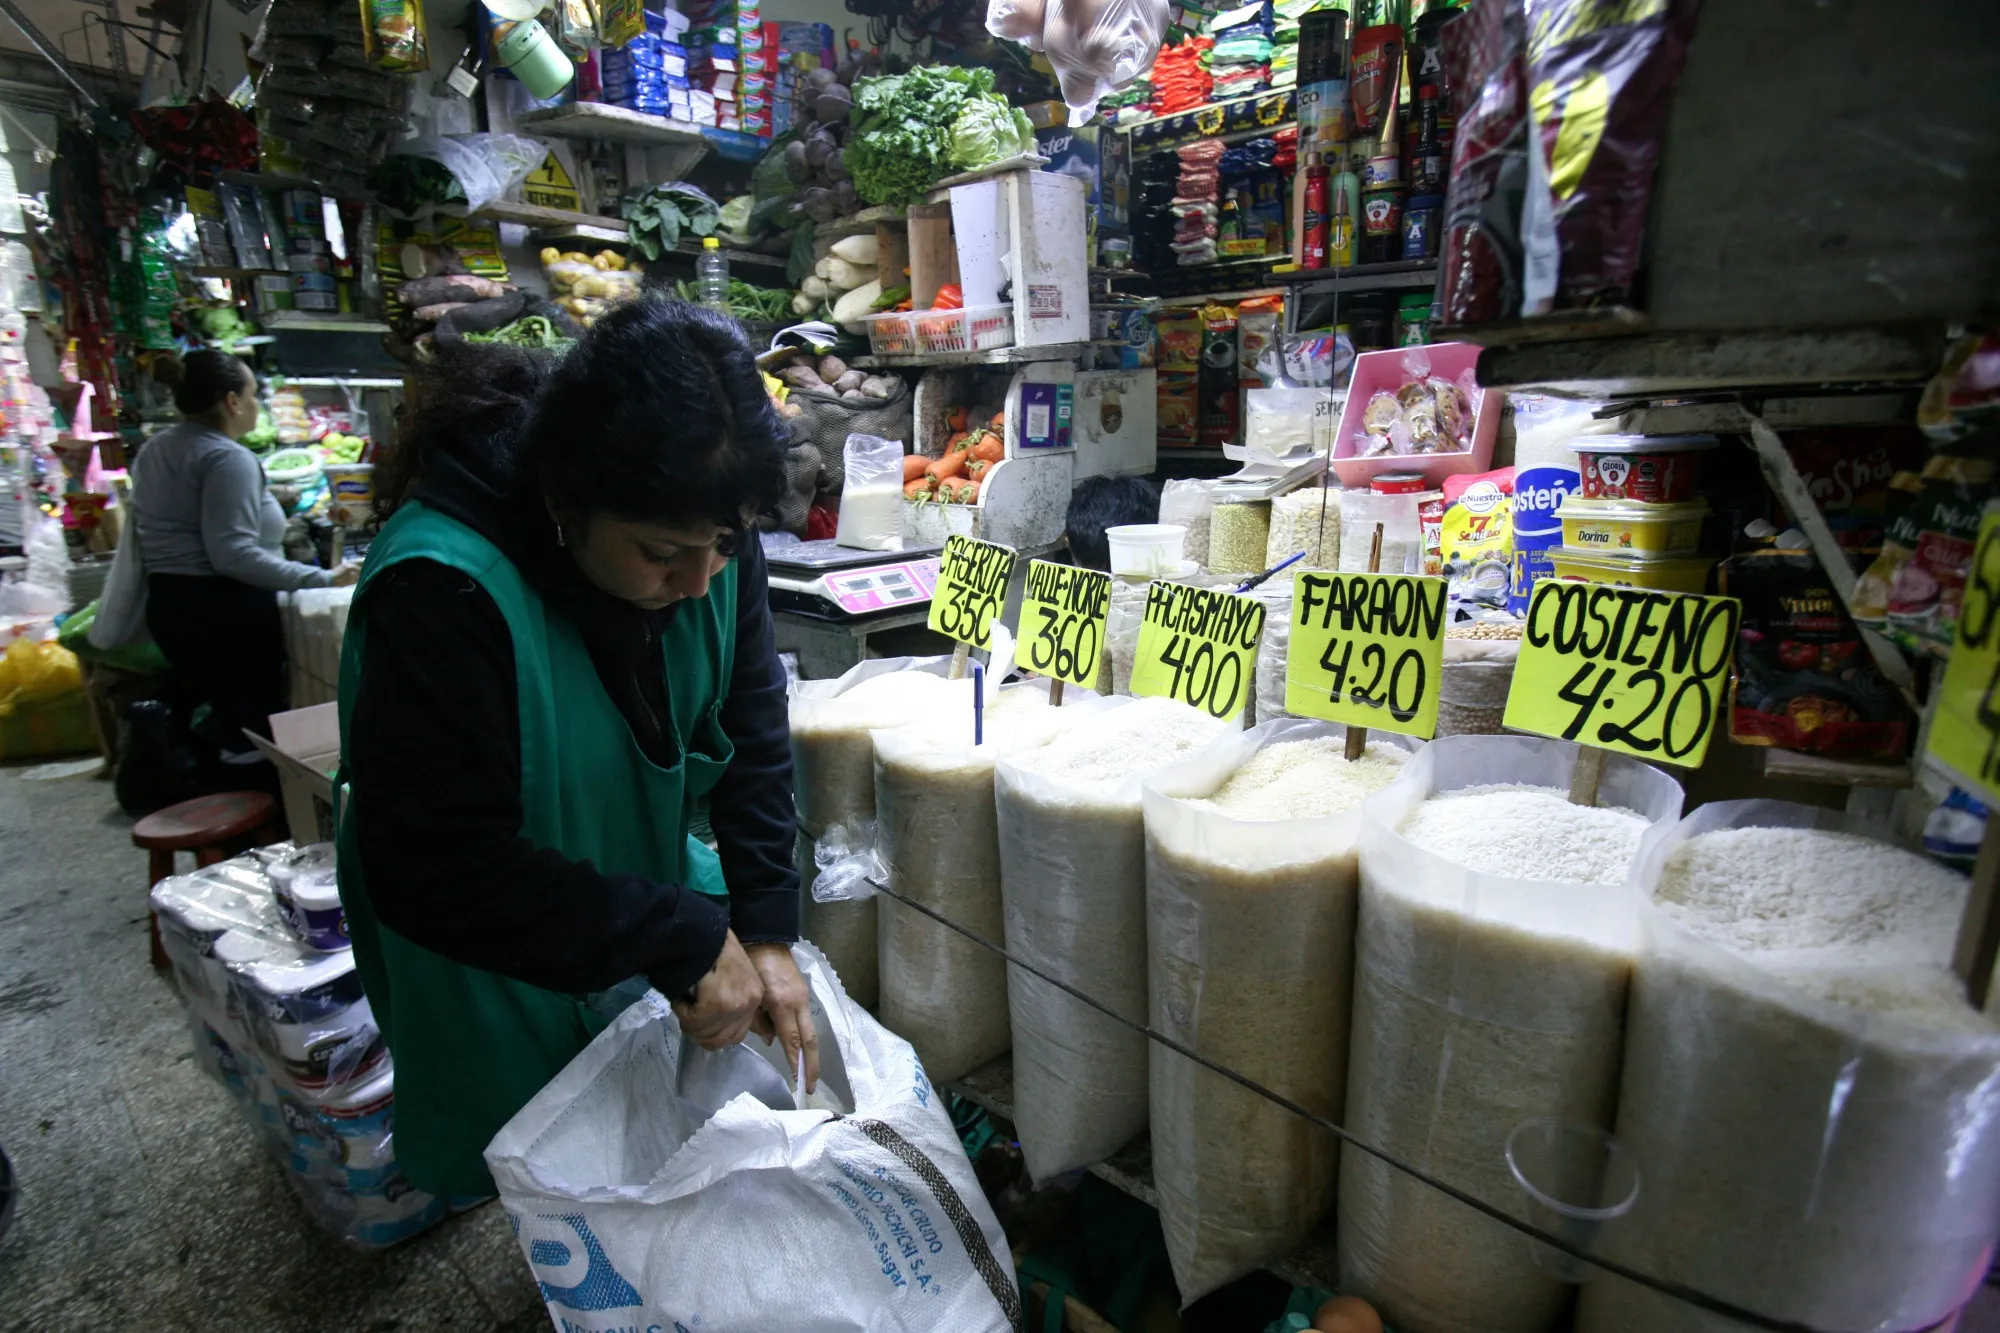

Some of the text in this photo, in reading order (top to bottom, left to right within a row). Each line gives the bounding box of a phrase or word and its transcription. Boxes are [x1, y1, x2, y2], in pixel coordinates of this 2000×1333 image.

[1040, 135, 1073, 157] ster
[1602, 461, 1625, 473] GLORIA
[1467, 493, 1503, 502] Nuestra
[1469, 516, 1491, 533] 7
[1459, 529, 1501, 541] Semillas
[1578, 530, 1609, 543] Dorina
[1145, 580, 1267, 650] PACASMAYO
[1300, 573, 1448, 642] FARAON
[909, 1207, 943, 1254] CRUDO
[874, 1241, 908, 1288] Sugar
